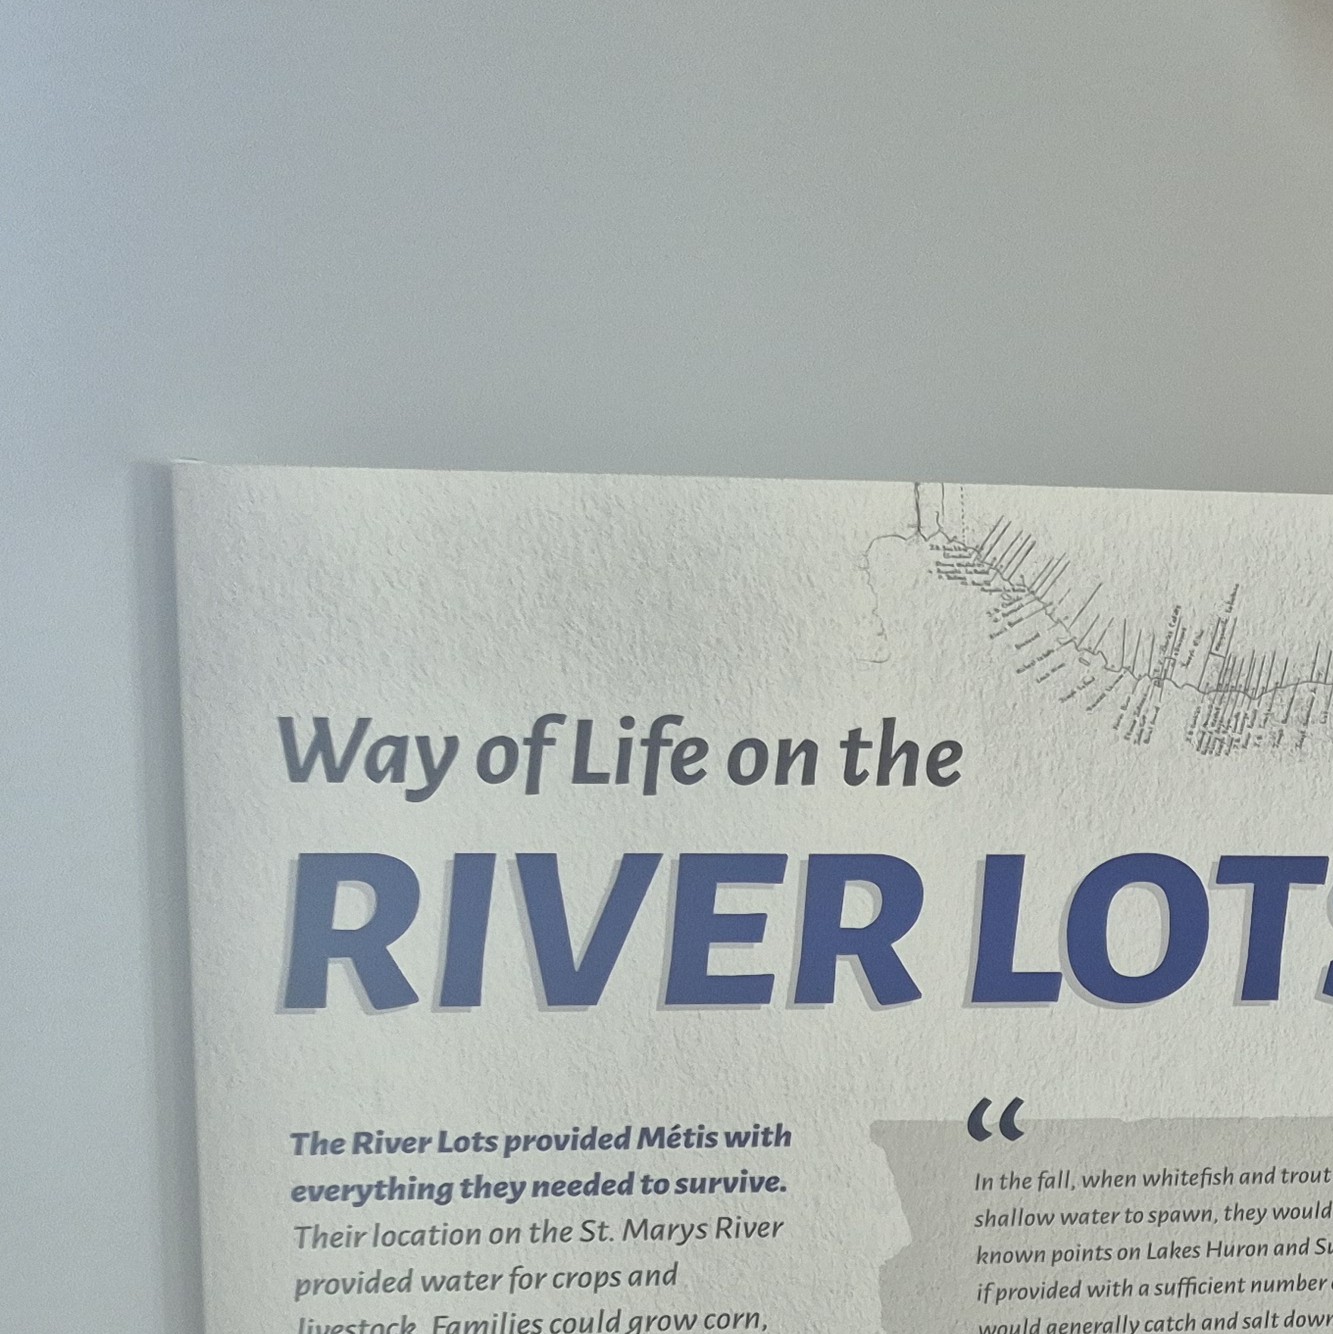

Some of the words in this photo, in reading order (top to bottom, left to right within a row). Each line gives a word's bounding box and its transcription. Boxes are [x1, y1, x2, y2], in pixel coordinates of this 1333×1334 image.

[277, 716, 460, 802] Way
[476, 713, 567, 796] of
[571, 714, 710, 797] Life
[727, 737, 818, 787] on
[840, 717, 964, 788] the
[278, 852, 924, 1012] RIVER
[289, 1130, 346, 1155] The
[351, 1129, 432, 1154] River
[436, 1129, 499, 1153] Lots
[502, 1124, 632, 1158] provided
[636, 1126, 718, 1149] Métis
[723, 1121, 791, 1148] with
[290, 1175, 454, 1207] everything
[459, 1173, 526, 1204] they
[530, 1170, 635, 1197] needed
[639, 1173, 670, 1195] to
[673, 1168, 787, 1194] survive.
[974, 1172, 993, 1191] In
[999, 1169, 1032, 1190] the
[1037, 1169, 1075, 1192] fall,
[1081, 1168, 1136, 1188] when
[1142, 1165, 1234, 1188] whitefish
[1238, 1165, 1276, 1185] and
[1280, 1166, 1331, 1184] trout
[975, 1245, 1045, 1264] known
[1050, 1243, 1112, 1267] points
[1116, 1246, 1140, 1260] on
[1146, 1239, 1200, 1259] Lakes
[1205, 1240, 1268, 1258] Huron
[1273, 1236, 1310, 1256] and
[548, 1308, 621, 1334] could
[703, 1311, 767, 1331] corn,
